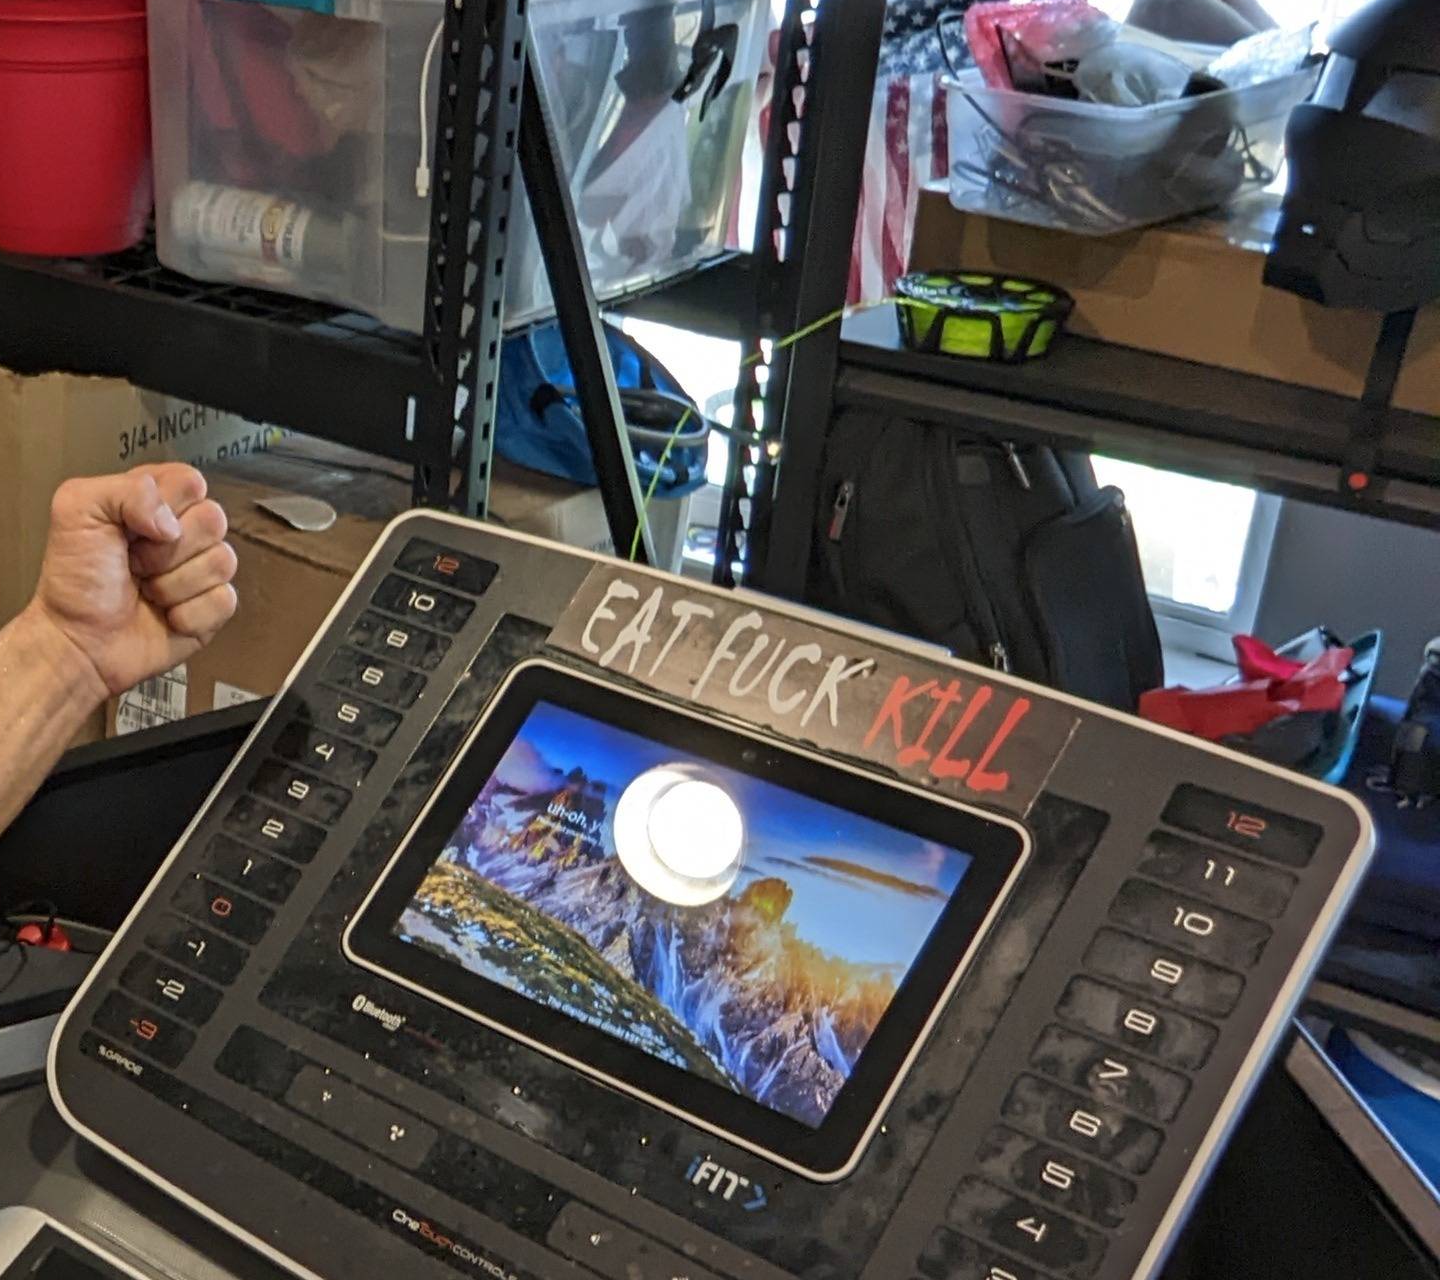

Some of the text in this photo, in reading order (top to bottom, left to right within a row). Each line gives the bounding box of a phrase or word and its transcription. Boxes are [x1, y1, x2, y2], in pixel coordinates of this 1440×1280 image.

[119, 403, 206, 461] 3/4-INCH
[433, 555, 459, 575] 12
[409, 591, 435, 611] 10
[387, 629, 408, 648] 8
[362, 666, 384, 685] 6
[580, 579, 1031, 792] EAT FUCK KILL
[338, 704, 360, 723] 5
[315, 743, 335, 761] 4
[287, 780, 309, 799] 3
[262, 819, 284, 838] 2
[1226, 811, 1266, 839] 12
[242, 858, 252, 875] 1
[1204, 859, 1235, 886] 11
[211, 897, 232, 916] 0
[1173, 906, 1214, 936] 10
[187, 941, 206, 957] -1
[1150, 959, 1183, 986] 9
[156, 978, 185, 1001] -2
[1124, 1009, 1156, 1035] 8
[1099, 1058, 1129, 1079] 7
[1069, 1110, 1101, 1137] 6
[1042, 1161, 1074, 1189] 5
[1016, 1217, 1047, 1242] 4
